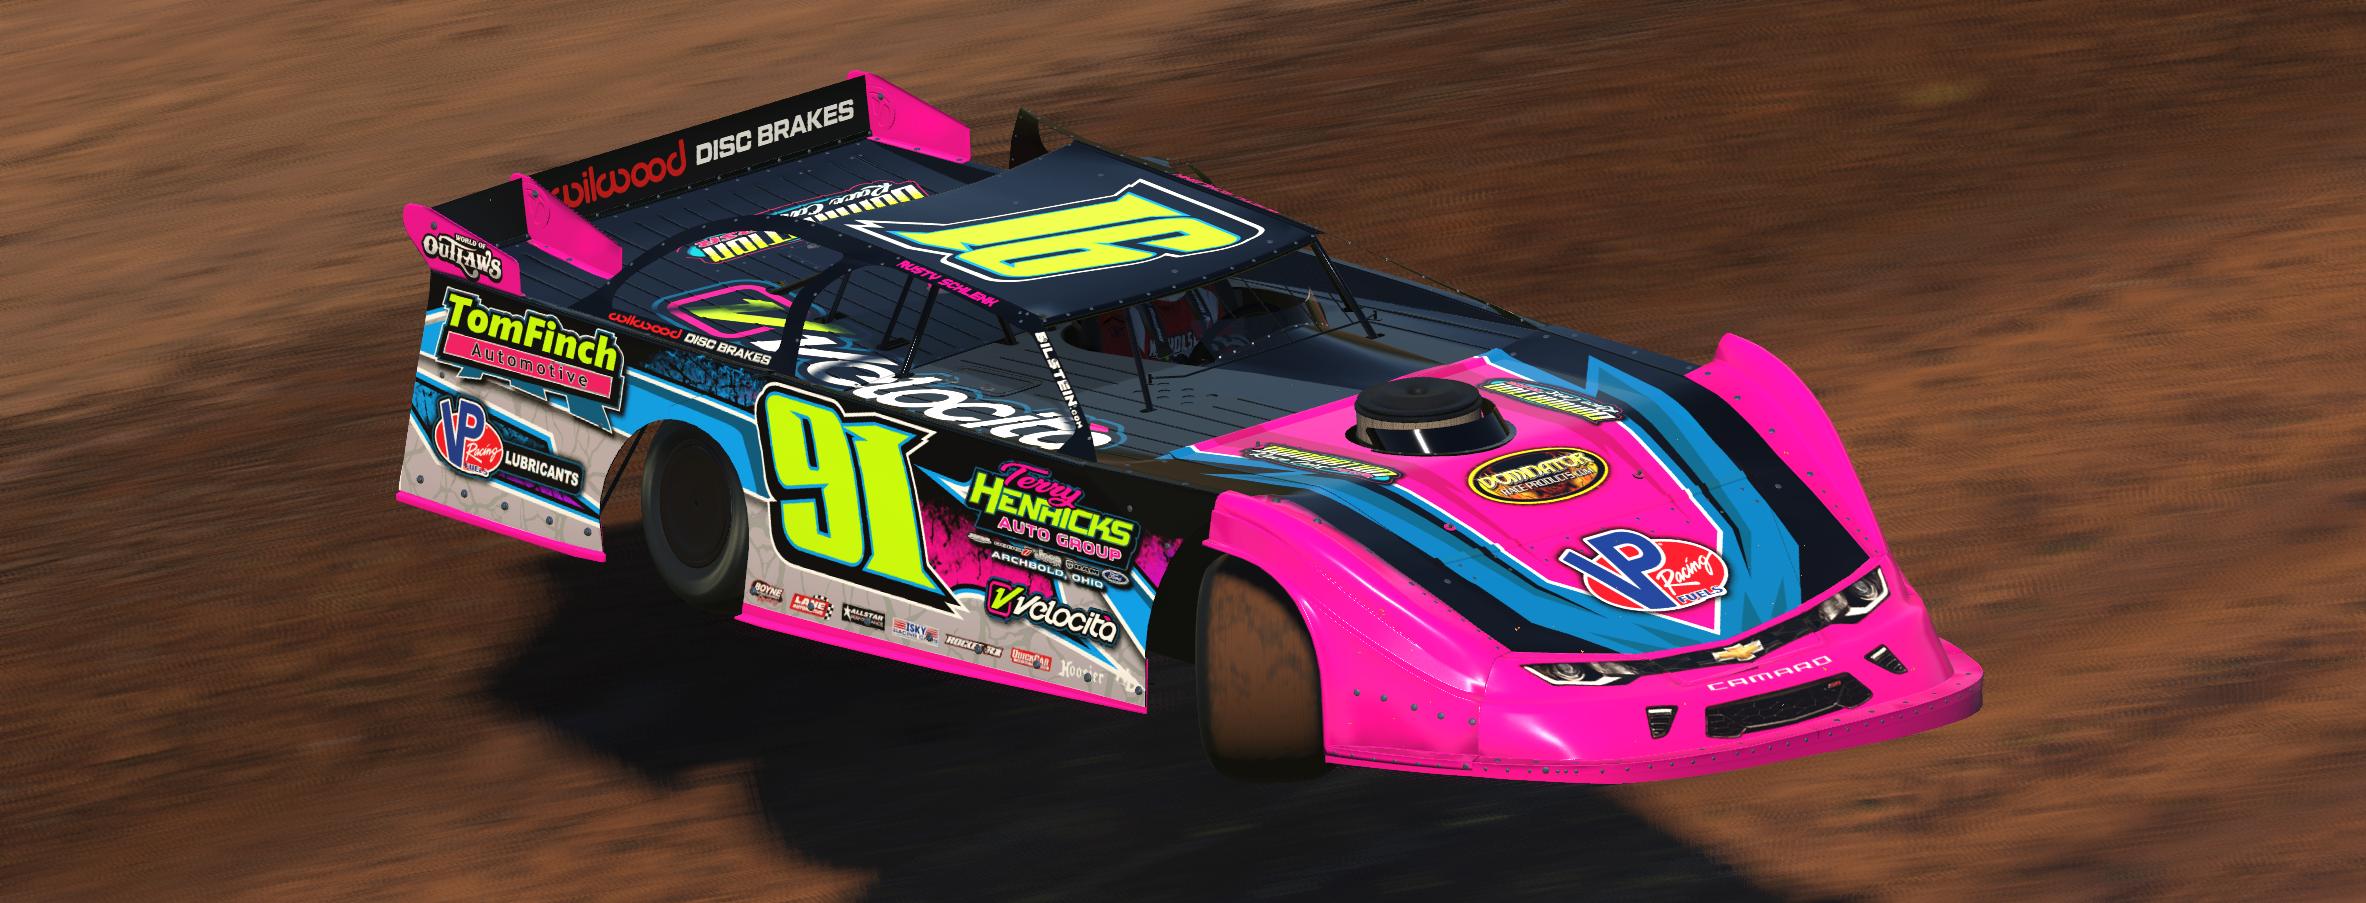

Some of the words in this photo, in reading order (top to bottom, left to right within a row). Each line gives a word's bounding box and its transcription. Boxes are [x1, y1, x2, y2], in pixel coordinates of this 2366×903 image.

[695, 130, 752, 166] DISC
[757, 98, 855, 148] BRAKES
[455, 234, 477, 247] WORLD
[478, 242, 487, 250] OF
[896, 260, 942, 280] RUSTY
[938, 278, 1000, 308] SCHLENK
[608, 311, 683, 340] wilwood
[684, 333, 717, 352] DISC
[716, 343, 772, 366] BRAKES
[471, 342, 589, 388] Automotive
[440, 398, 486, 470] VP
[465, 442, 502, 464] Racing
[505, 450, 580, 486] LUBRICANTS
[1000, 462, 1082, 509] Terry
[1478, 452, 1595, 489] DOMINATOR
[765, 391, 942, 596] 91
[997, 516, 1050, 543] AUTO
[1056, 533, 1122, 562] GROUP
[755, 582, 783, 597] BOYNE
[991, 551, 1067, 580] ARCHBOLD,
[1072, 574, 1104, 589] OHIO
[1558, 529, 1667, 611] VP
[1656, 550, 1715, 596] Racing
[851, 608, 884, 621] ALLSTAR
[1677, 585, 1724, 604] FUELS
[906, 623, 927, 635] ISKY
[1707, 655, 1833, 691] CAMARO
